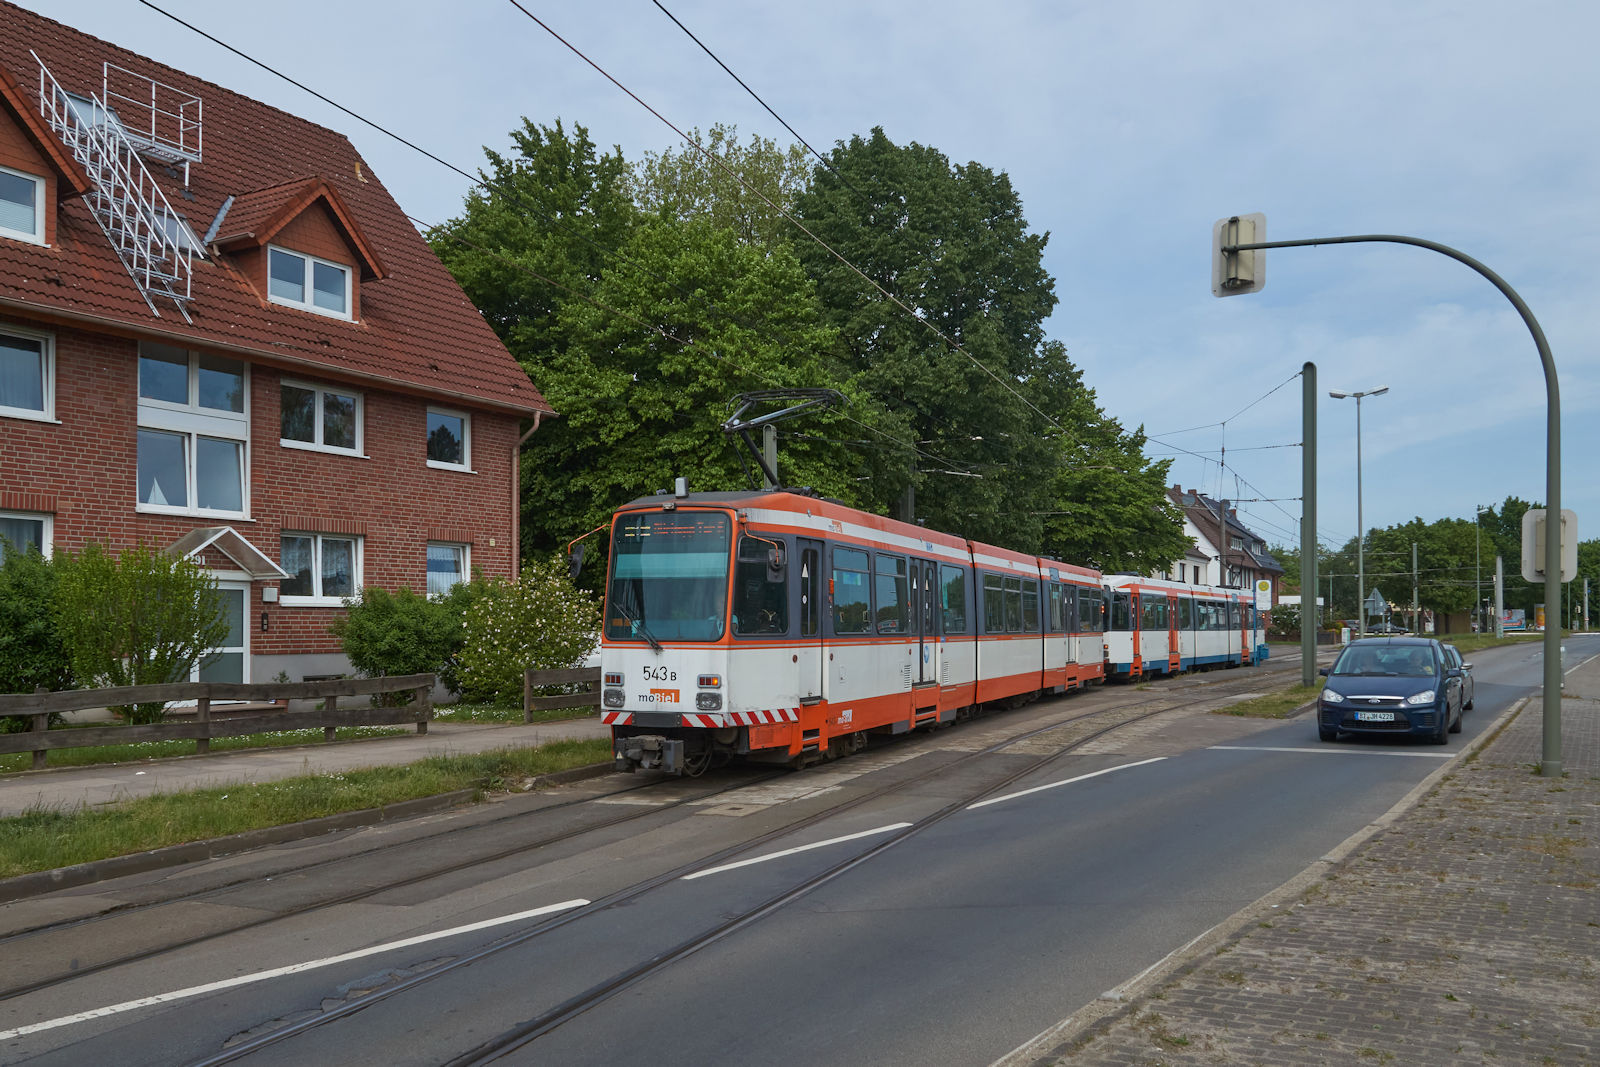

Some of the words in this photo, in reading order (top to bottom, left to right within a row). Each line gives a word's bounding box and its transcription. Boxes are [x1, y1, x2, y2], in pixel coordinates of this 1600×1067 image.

[190, 555, 206, 565] 291
[643, 666, 668, 681] 543
[670, 671, 677, 681] B
[638, 692, 676, 703] moBiel
